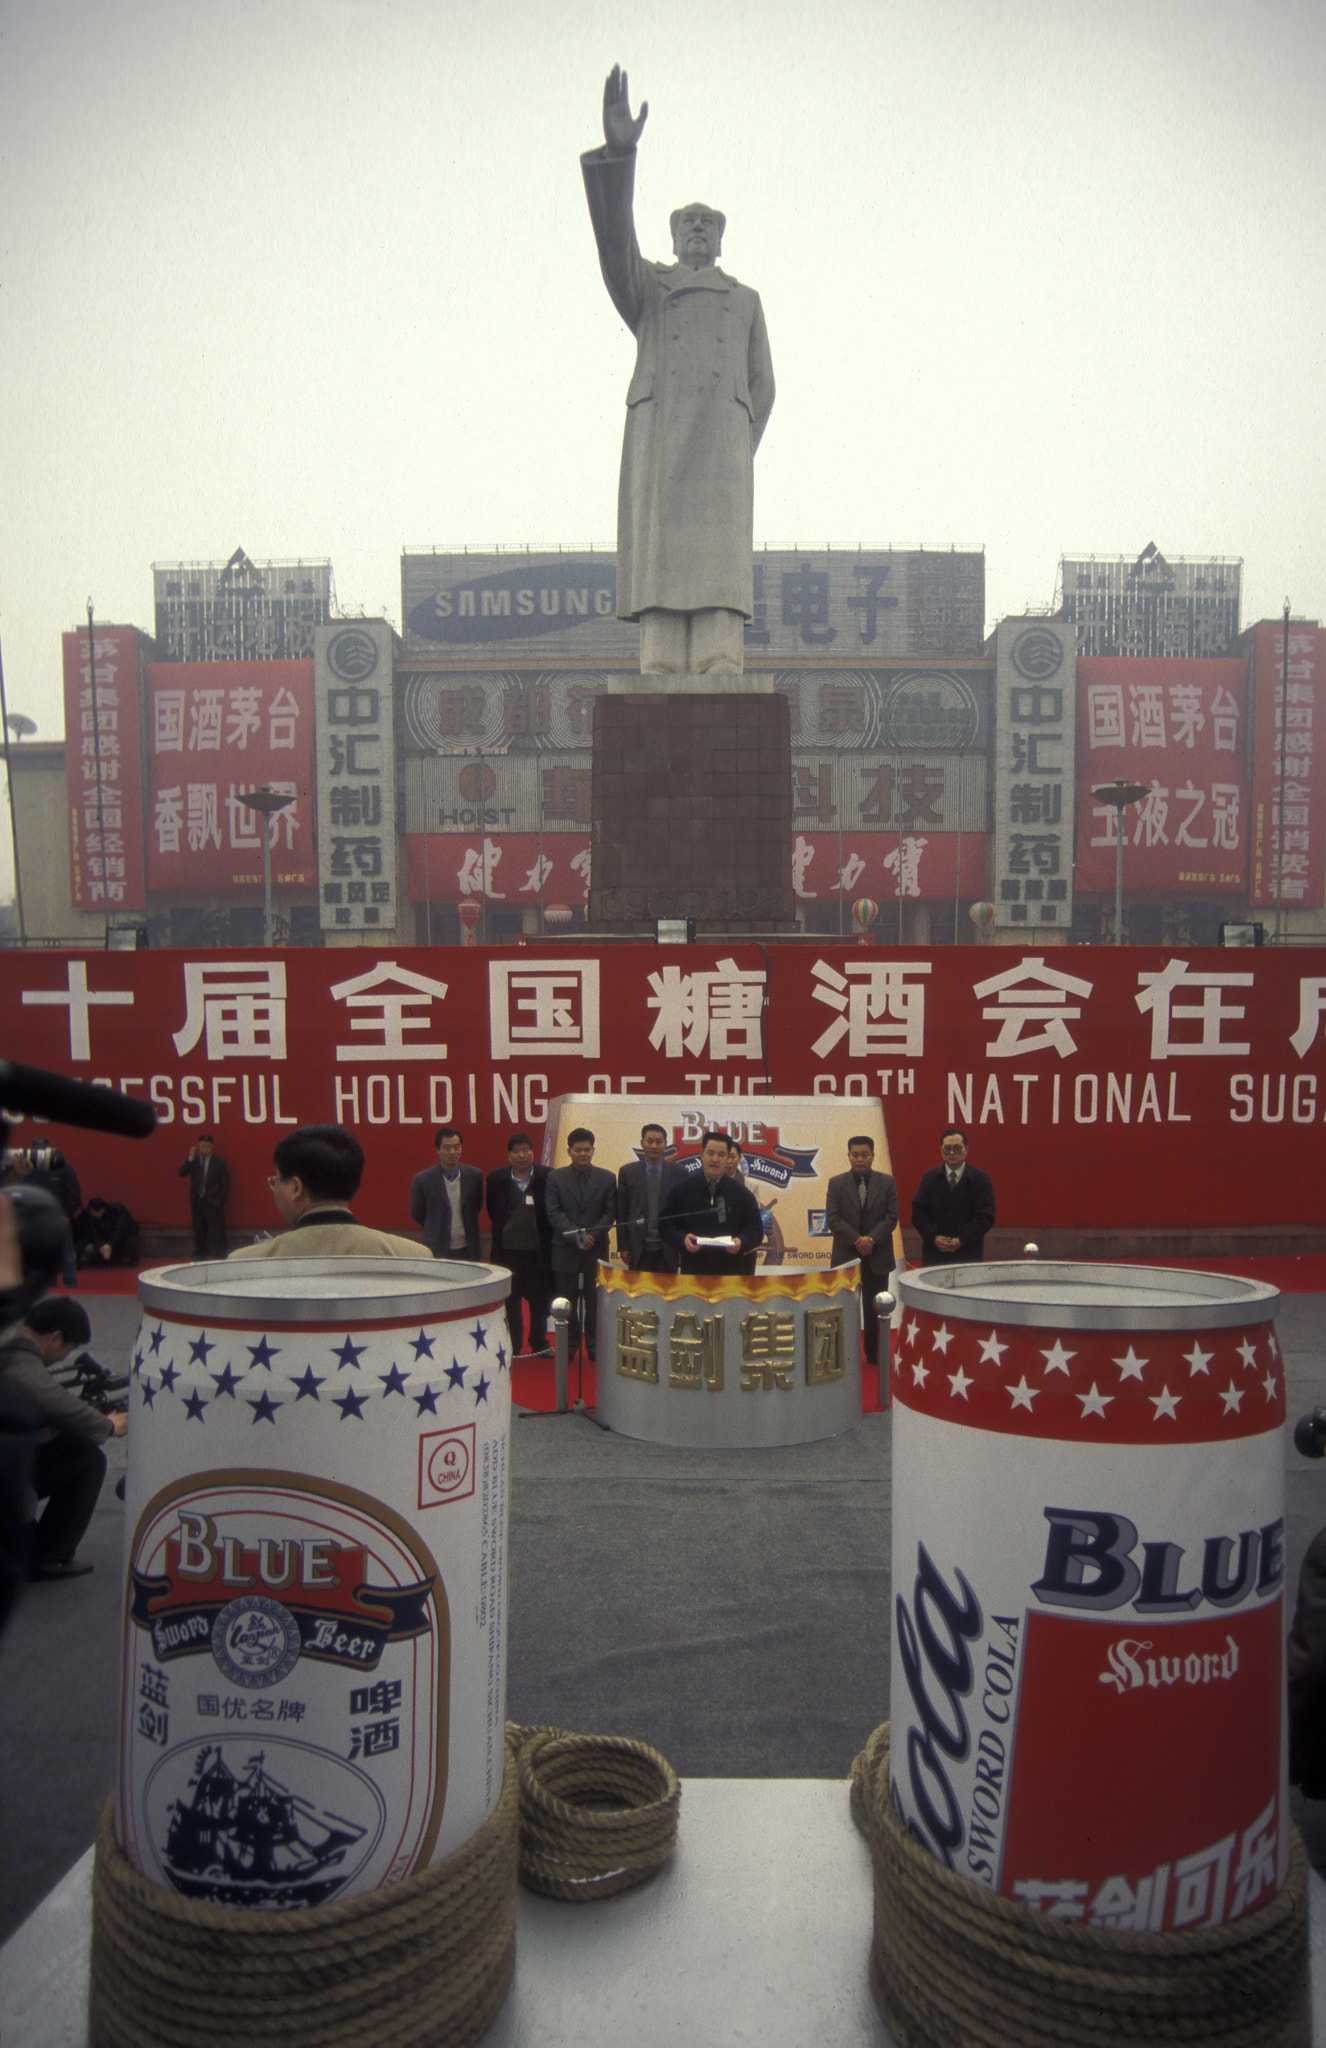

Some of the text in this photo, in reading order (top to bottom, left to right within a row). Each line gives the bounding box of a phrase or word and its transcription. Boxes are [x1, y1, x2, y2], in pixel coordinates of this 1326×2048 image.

[434, 588, 613, 618] SAMSUNG
[153, 686, 300, 754] 国酒茅台
[1087, 684, 1241, 752] 国酒茅台
[327, 686, 381, 877] 中汇制药
[1009, 685, 1063, 876] 中汇制药
[154, 781, 300, 853] 香飘世界
[438, 808, 516, 827] HOIST
[1091, 779, 1240, 850] 玉液之冠
[335, 1073, 549, 1125] HOLDING
[947, 1072, 1192, 1125] NATIONAL
[1229, 1073, 1326, 1124] SUG
[681, 1111, 768, 1146] BLUE
[750, 1158, 789, 1182] Sword
[787, 1251, 814, 1260] SWORD
[815, 1251, 832, 1260] GRO
[437, 1468, 462, 1485] CHINA
[177, 1510, 342, 1591] BLUE
[1030, 1506, 1285, 1614] BLUE
[153, 1616, 376, 1660] Sword Beer
[1099, 1634, 1240, 1695] Sword
[197, 1694, 306, 1724] 国优名牌
[348, 1679, 402, 1761] 啤酒
[967, 1613, 1020, 1886] SWORD COLA
